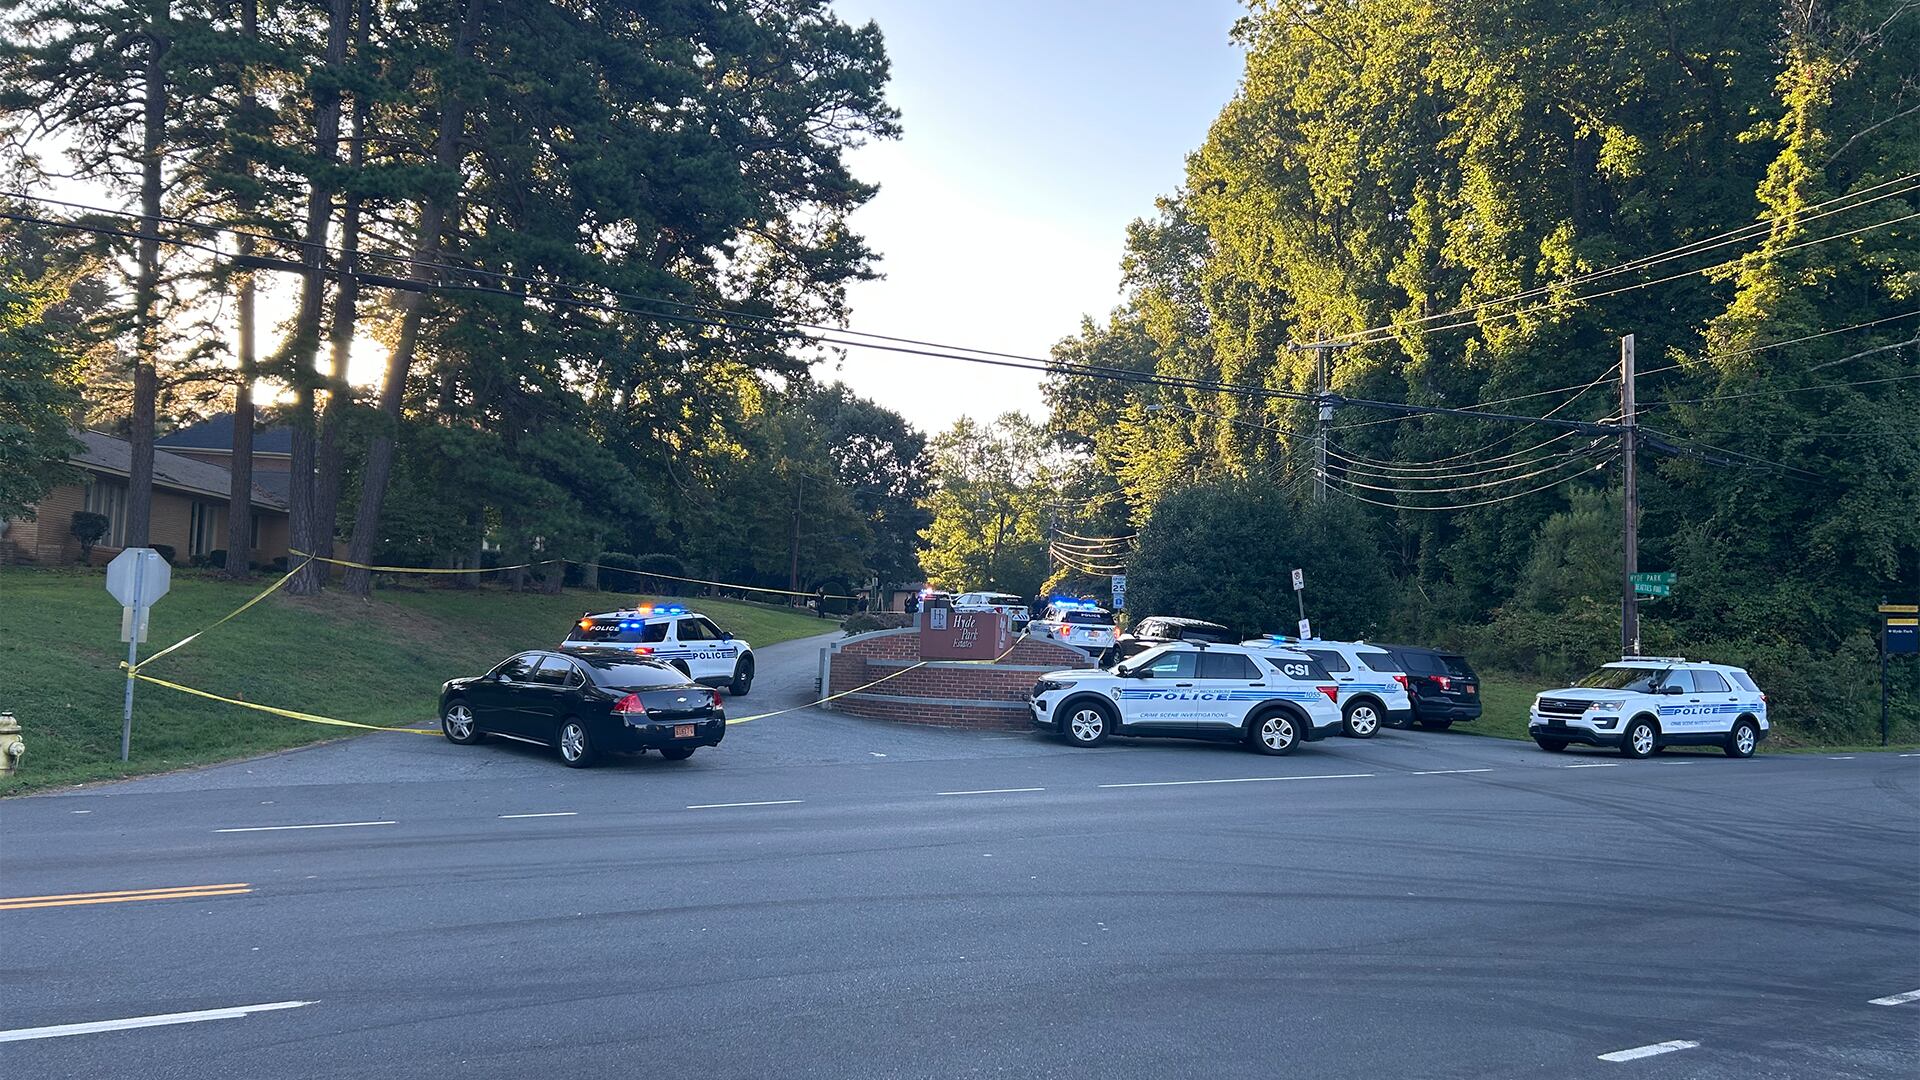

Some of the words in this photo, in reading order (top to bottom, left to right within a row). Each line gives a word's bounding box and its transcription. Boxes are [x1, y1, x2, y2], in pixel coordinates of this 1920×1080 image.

[953, 615, 976, 628] Hyde
[961, 628, 979, 640] Park
[692, 652, 727, 660] POLICE
[1284, 663, 1309, 676] CSI
[1148, 693, 1229, 701] POLICE
[1673, 707, 1719, 715] POLICE
